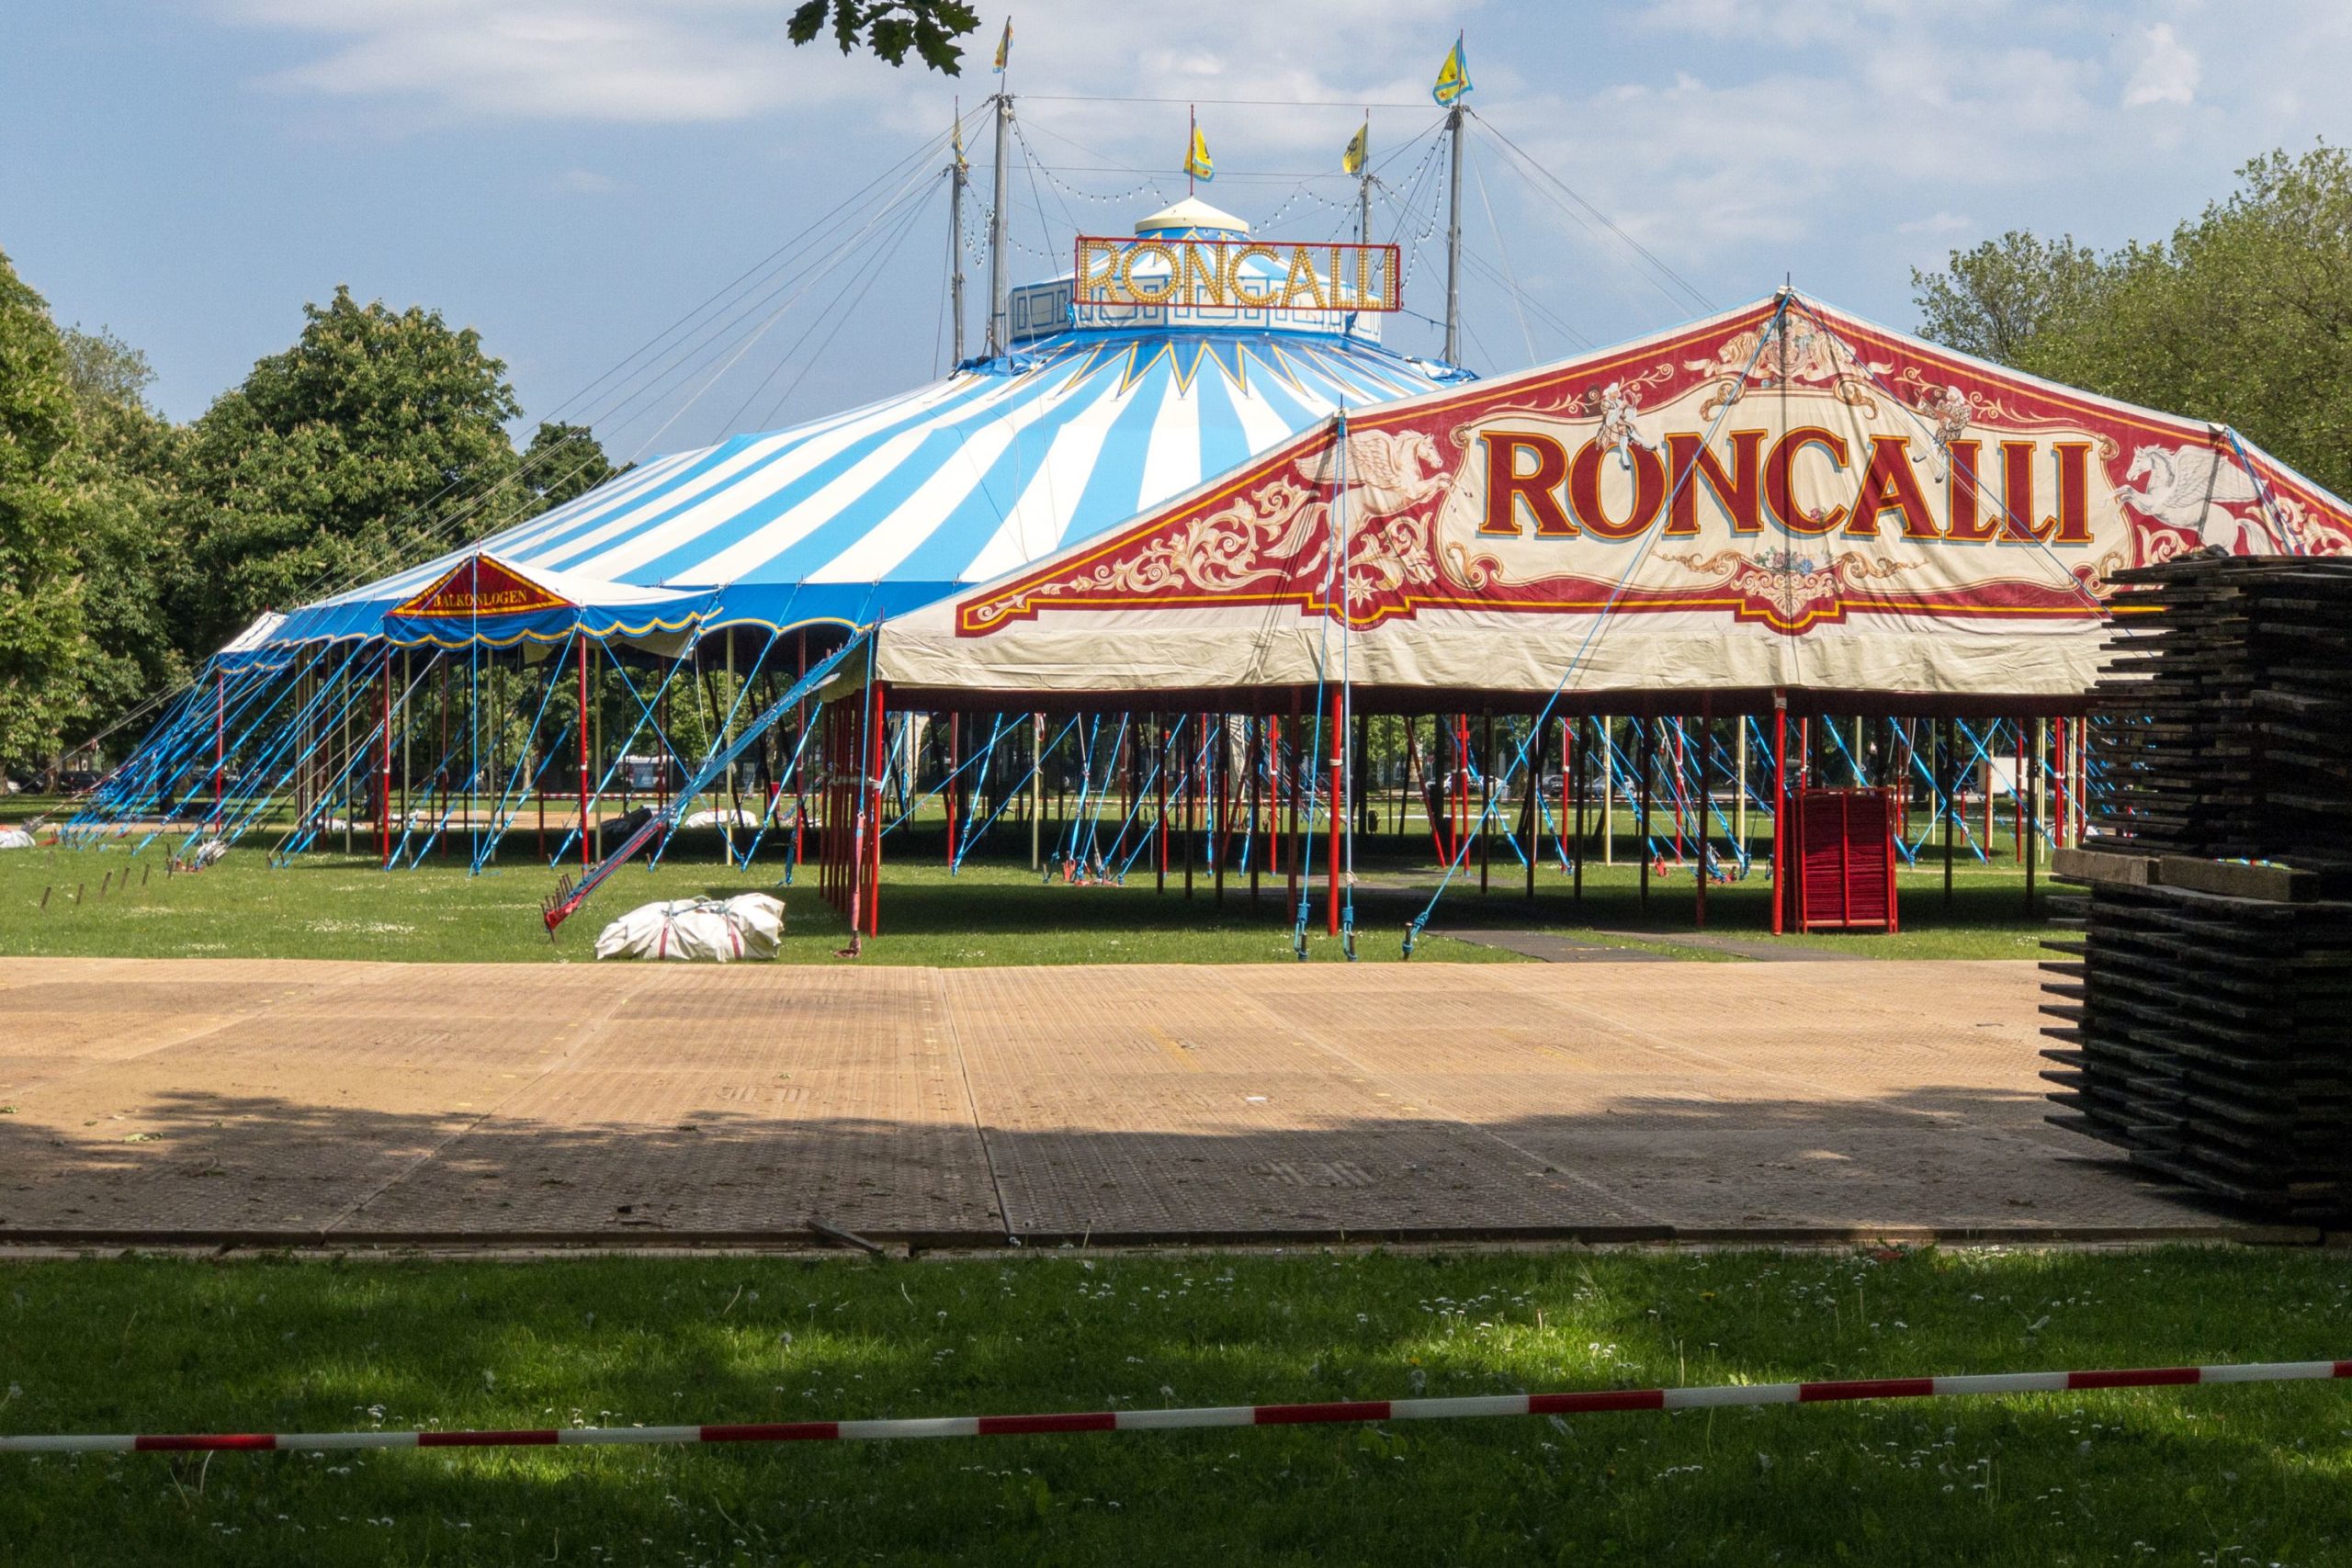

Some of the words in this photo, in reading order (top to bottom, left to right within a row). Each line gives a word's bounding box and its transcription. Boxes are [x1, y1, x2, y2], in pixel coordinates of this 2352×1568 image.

[1080, 241, 1395, 310] RONCALLI
[1476, 426, 2096, 544] RONCALLI
[433, 589, 528, 607] BALKONLOGEN
